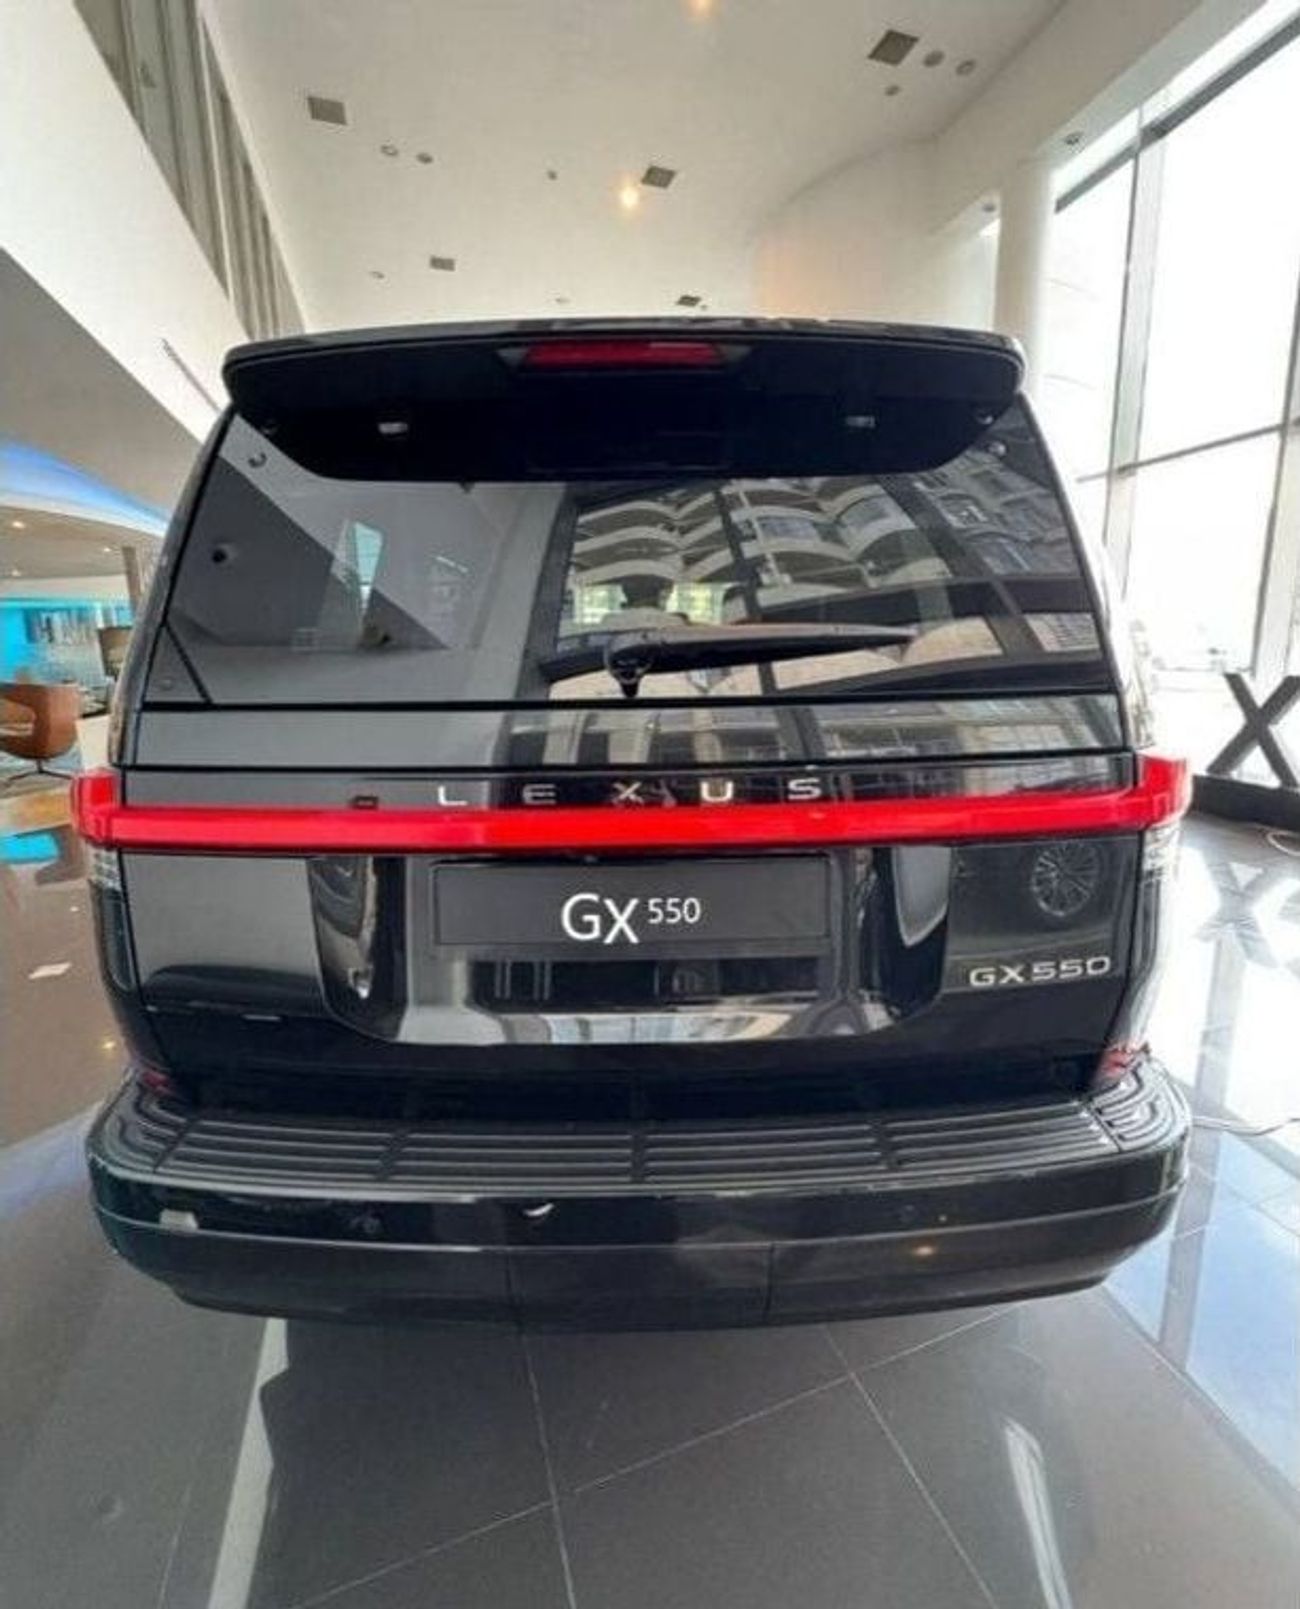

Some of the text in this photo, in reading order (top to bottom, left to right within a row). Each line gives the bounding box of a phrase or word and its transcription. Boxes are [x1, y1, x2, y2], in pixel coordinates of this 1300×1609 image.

[437, 778, 823, 806] LEXUS
[560, 893, 701, 944] GX 550
